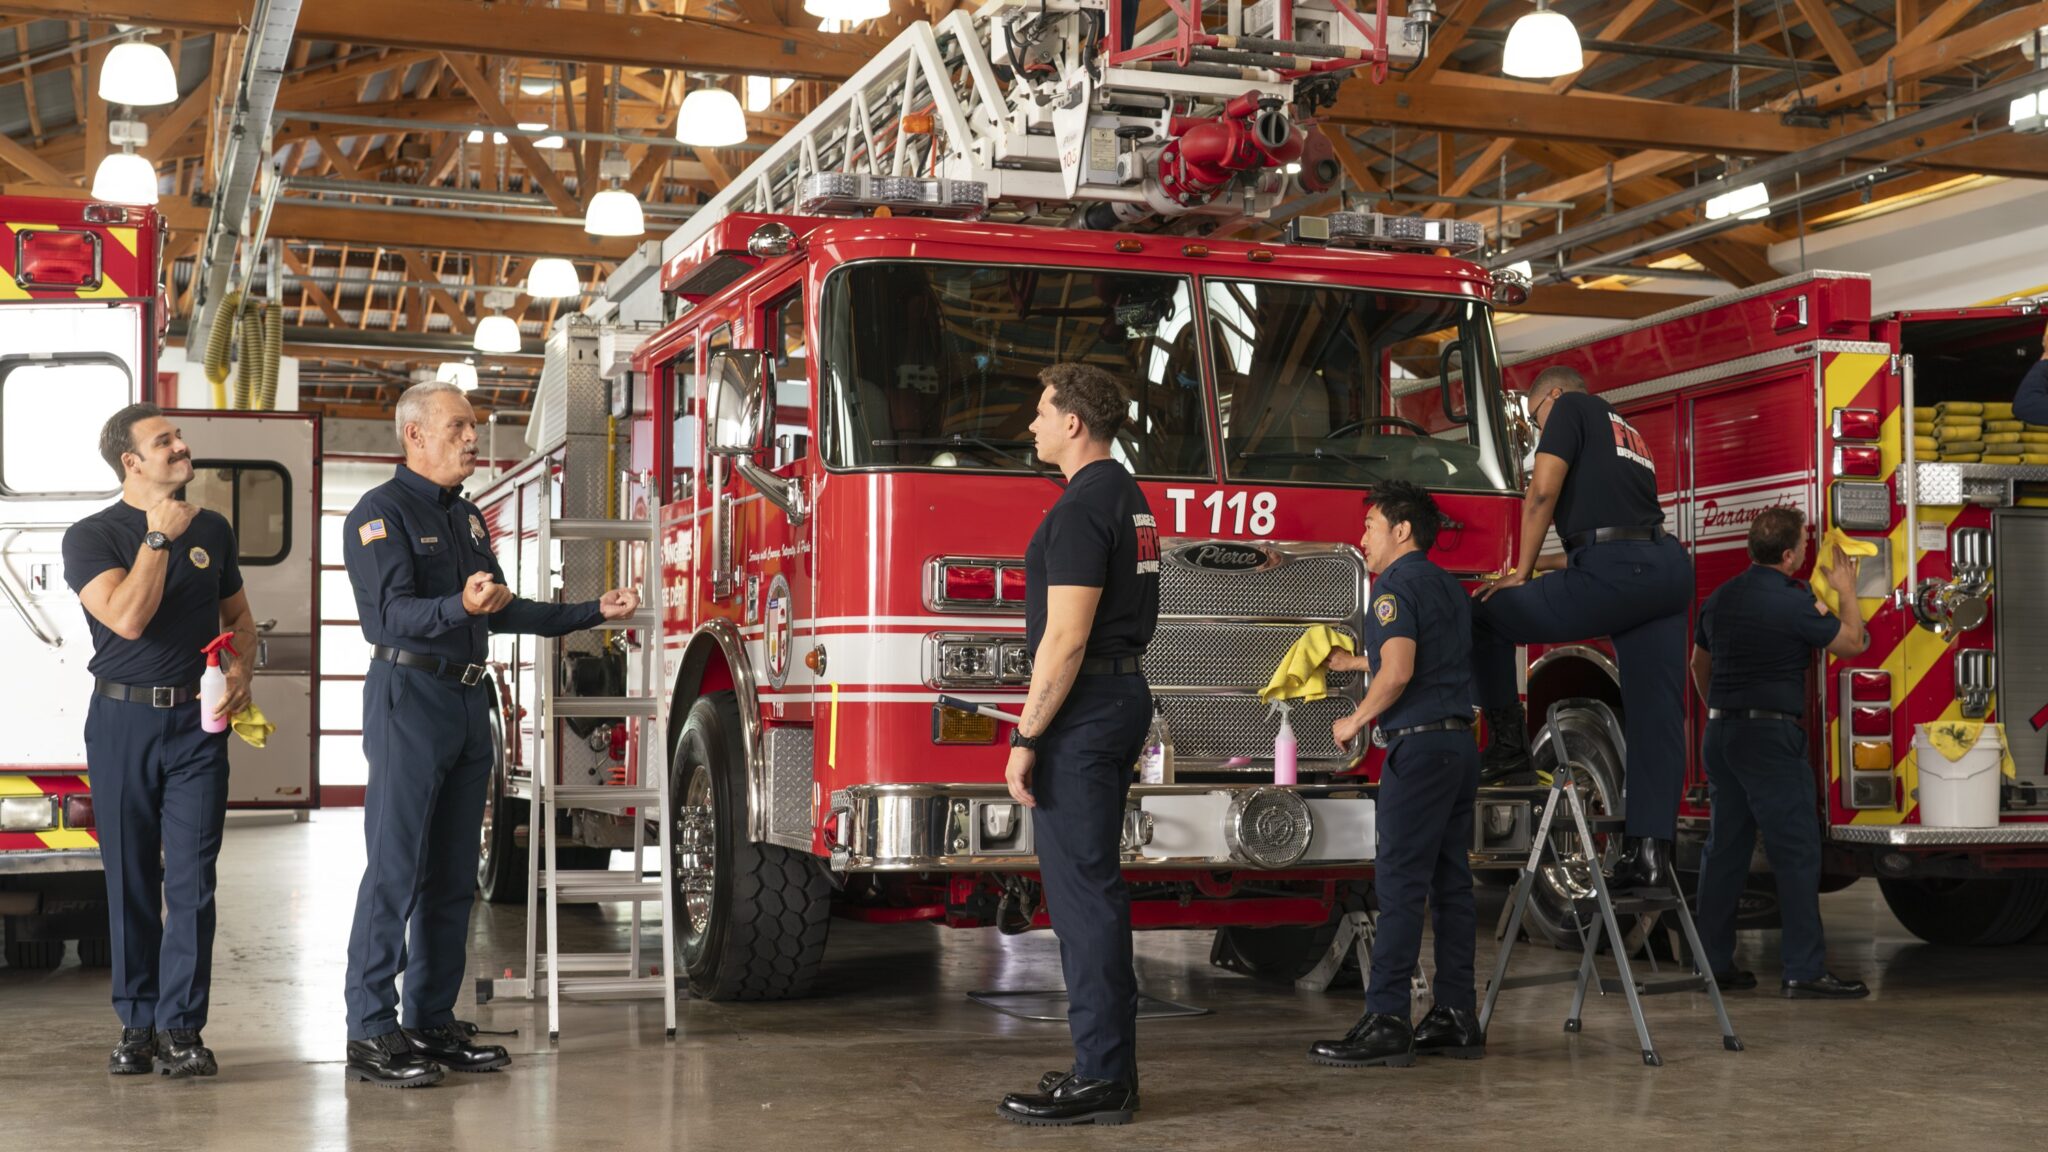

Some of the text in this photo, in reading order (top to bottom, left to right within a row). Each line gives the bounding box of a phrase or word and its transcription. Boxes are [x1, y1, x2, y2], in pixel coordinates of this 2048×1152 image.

[1612, 421, 1654, 461] FIR
[1167, 489, 1277, 535] T 118
[1195, 545, 1257, 567] Pierce
